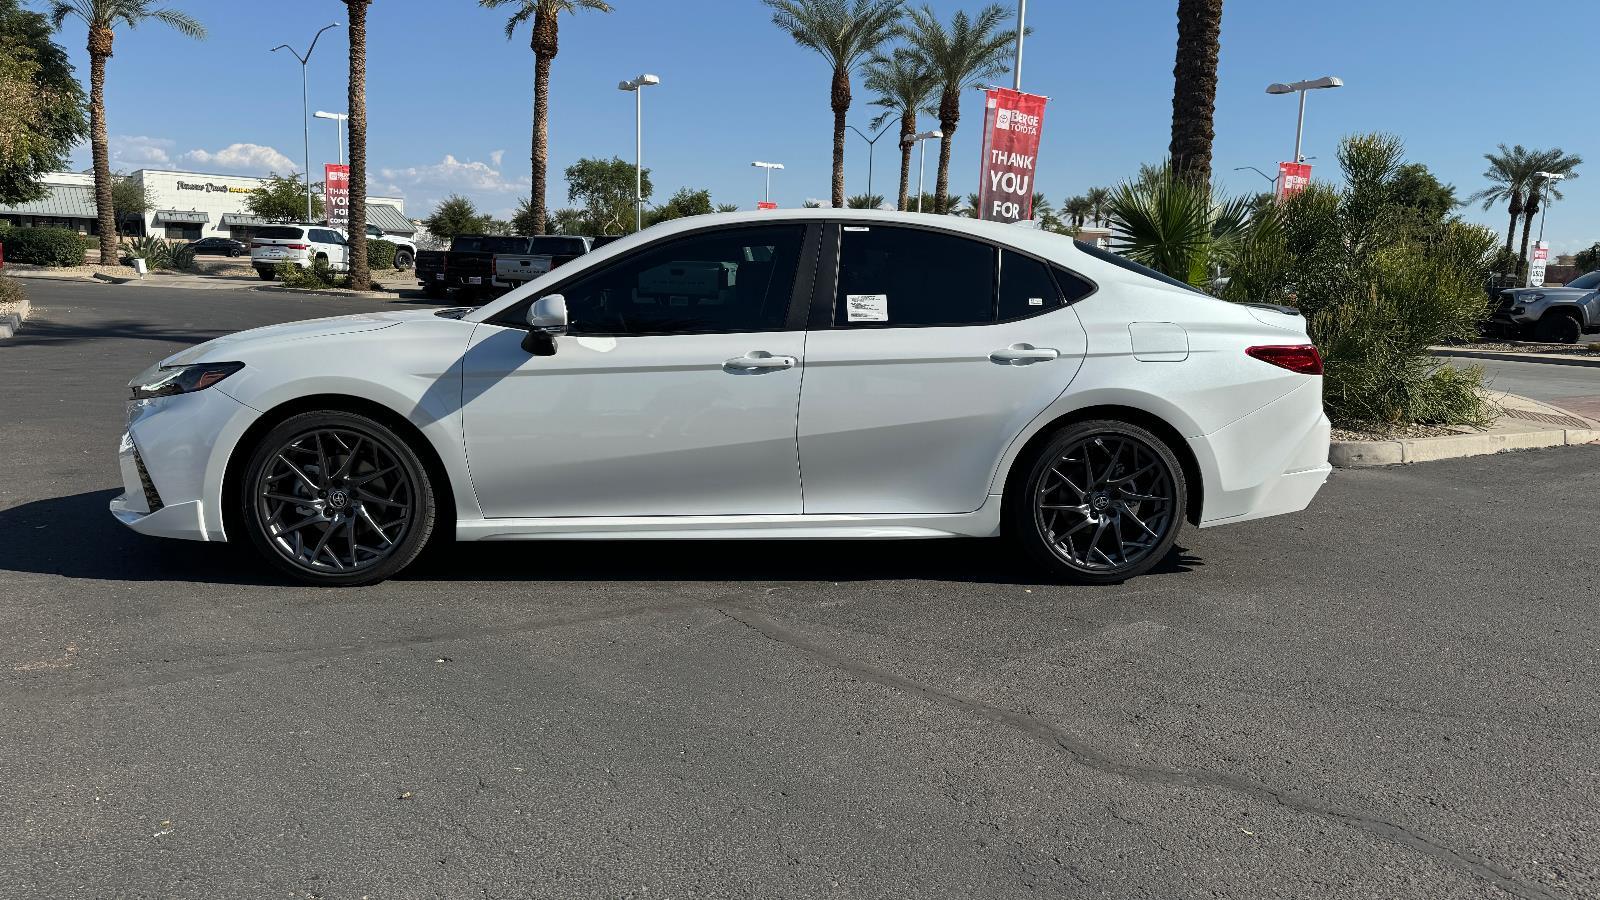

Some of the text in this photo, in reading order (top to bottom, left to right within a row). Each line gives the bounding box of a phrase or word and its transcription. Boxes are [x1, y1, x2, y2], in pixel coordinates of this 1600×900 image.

[1011, 110, 1039, 127] BERGE
[1010, 123, 1037, 136] TOYOTA
[992, 149, 1033, 170] THANK
[329, 187, 349, 195] THAN
[990, 169, 1029, 196] YOU
[992, 200, 1019, 220] FOR
